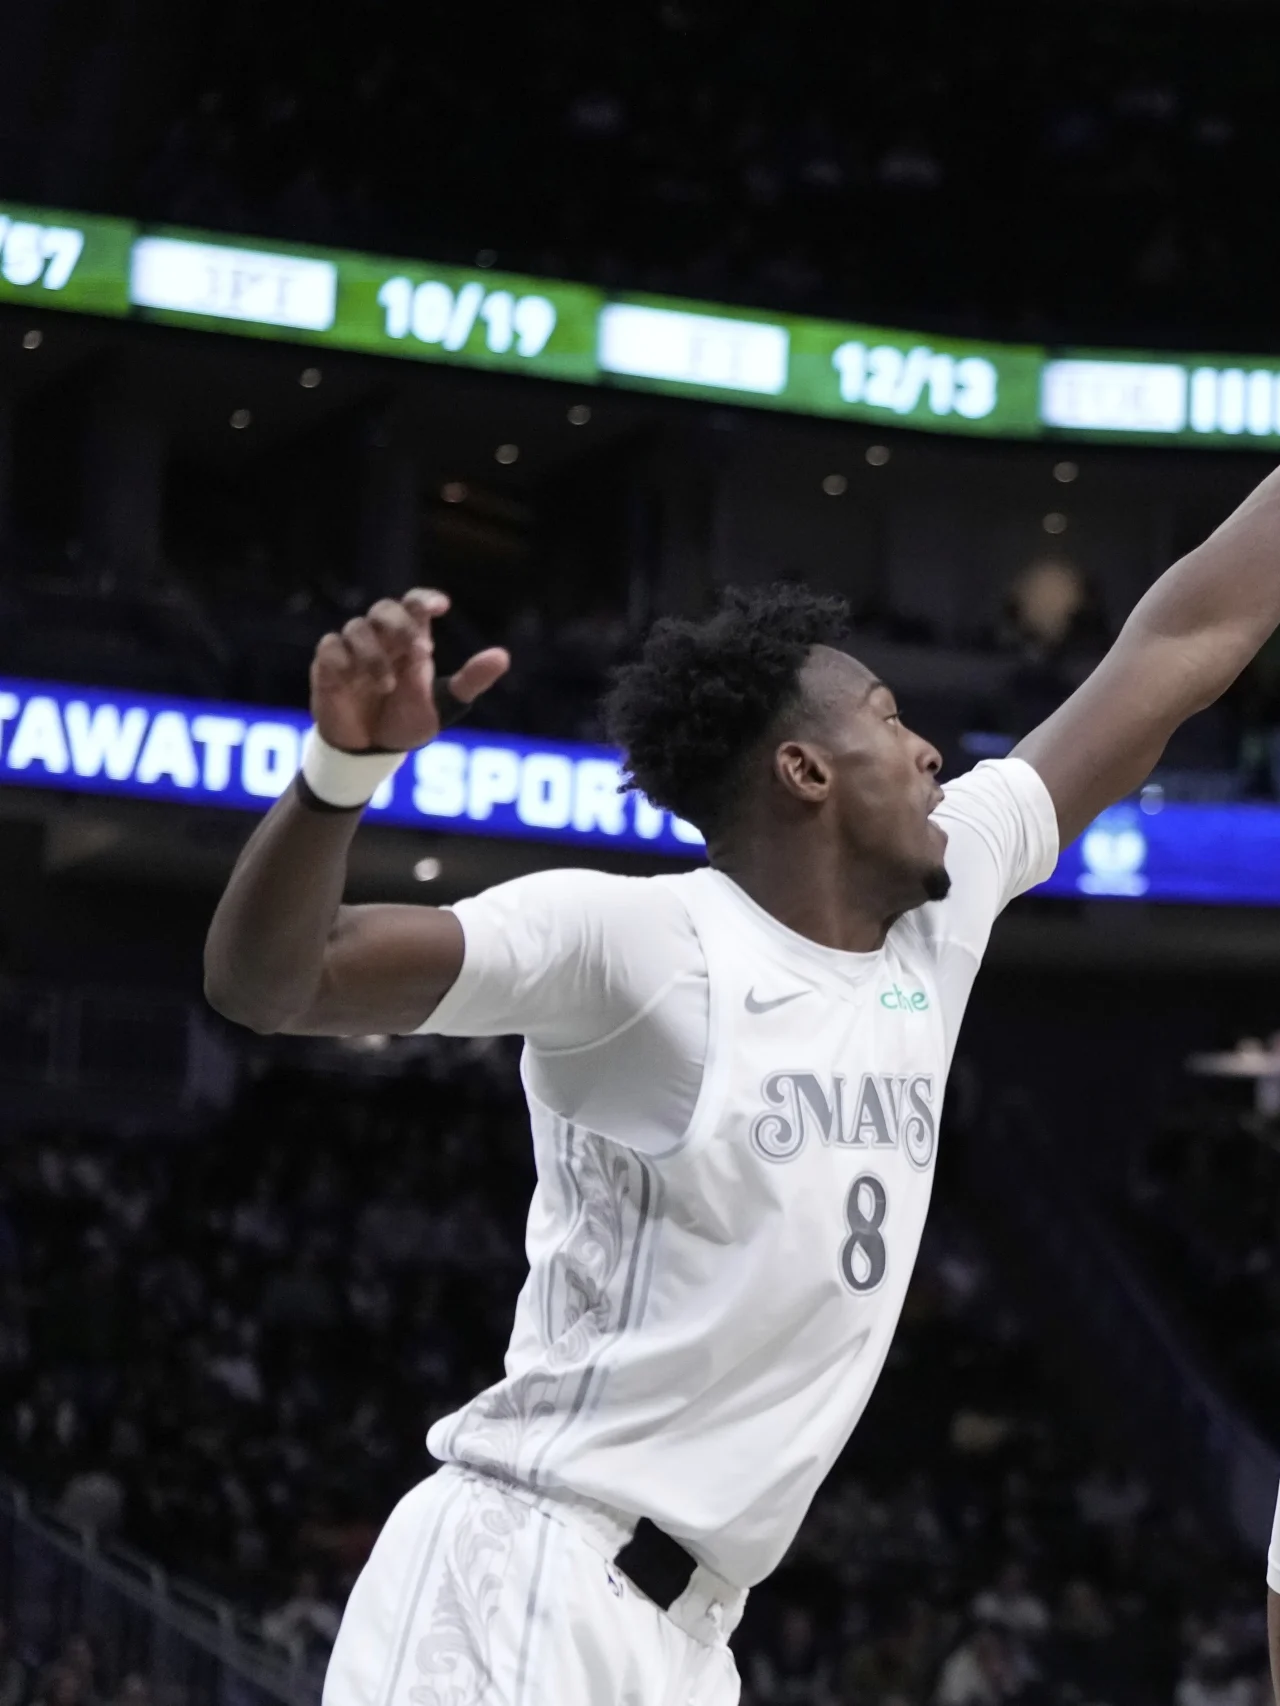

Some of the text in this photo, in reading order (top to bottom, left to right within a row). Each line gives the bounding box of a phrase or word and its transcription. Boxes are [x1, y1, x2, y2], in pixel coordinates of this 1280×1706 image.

[378, 276, 556, 357] 10/19
[832, 341, 997, 419] 12/13
[751, 1069, 937, 1173] MAVS
[839, 1170, 889, 1295] 8
